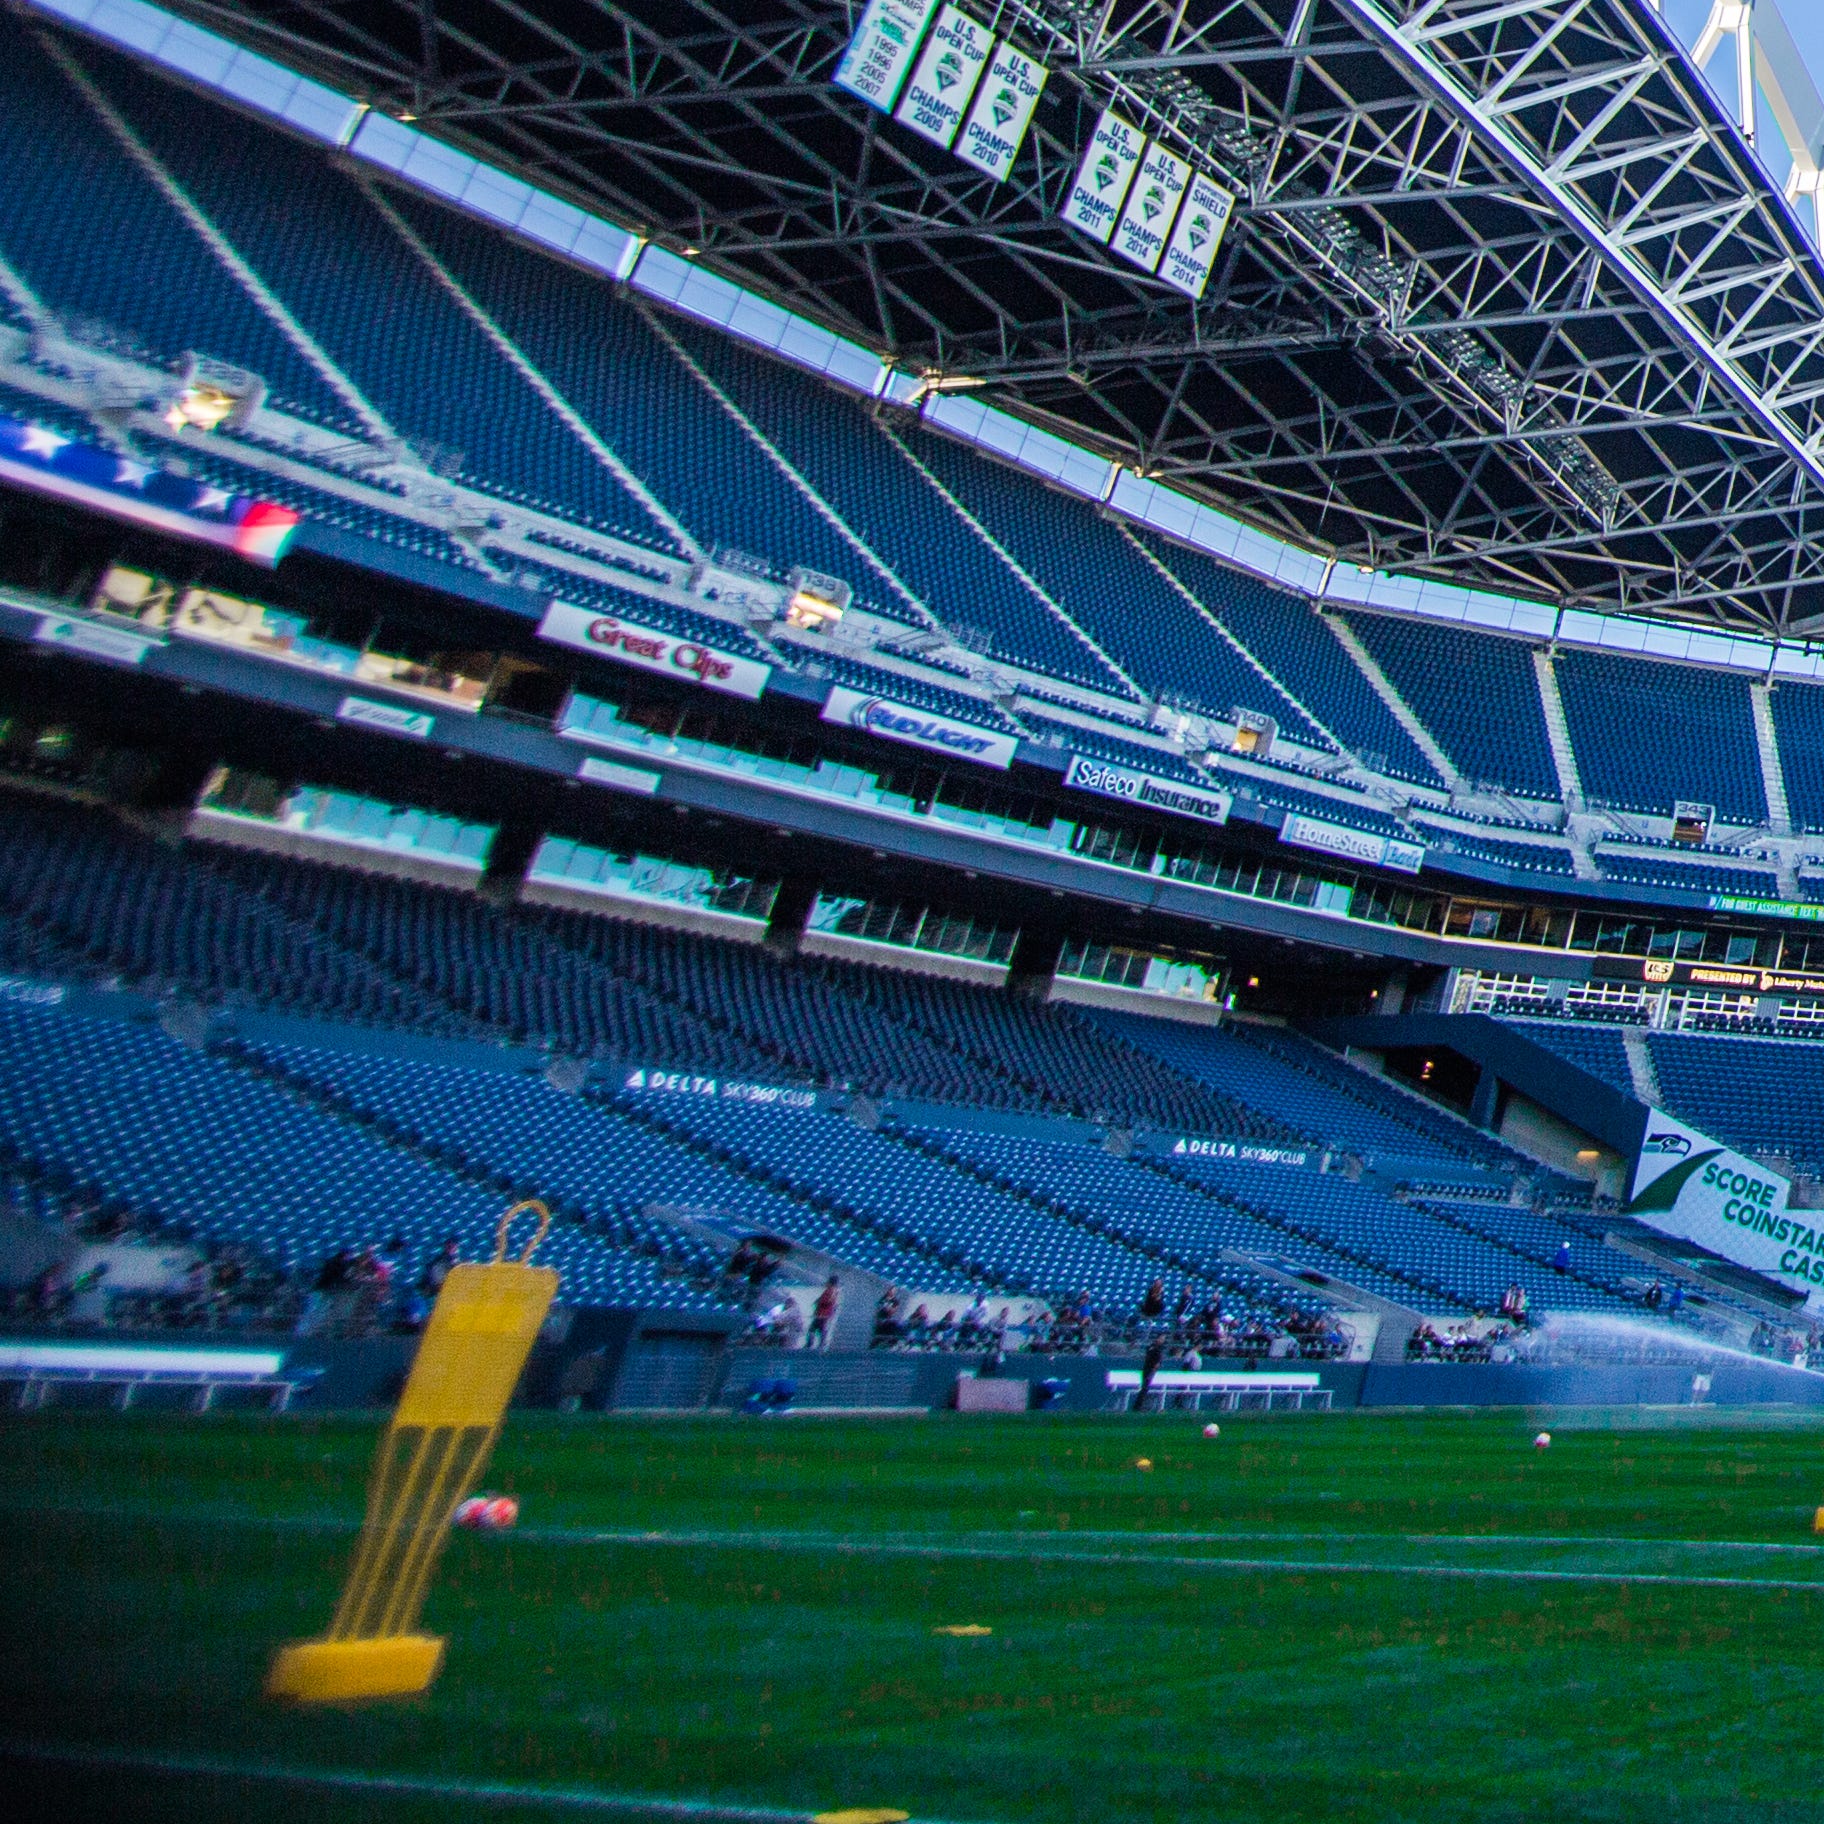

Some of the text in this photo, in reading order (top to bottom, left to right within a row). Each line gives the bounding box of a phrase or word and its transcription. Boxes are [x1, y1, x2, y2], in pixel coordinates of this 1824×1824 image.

[935, 26, 963, 51] OPEN
[963, 41, 986, 63] CUP
[954, 18, 978, 45] U.S.
[860, 61, 888, 85] 2005
[992, 62, 1041, 100] OPEN CUP
[1009, 54, 1031, 81] U.S.
[853, 74, 882, 98] 2007
[909, 86, 961, 126] CHAMPS
[913, 107, 944, 133] 2009
[967, 122, 1017, 160] CHAMPS
[1096, 130, 1139, 163] OPEN CUP
[1111, 122, 1131, 146] U.S.
[971, 142, 1000, 168] 2010
[1158, 154, 1177, 177] U.S.
[1144, 162, 1184, 194] OPEN CUP
[1073, 186, 1117, 223] CHAMPS
[1077, 206, 1102, 229] 2011
[1193, 190, 1227, 220] SHIELD
[1122, 217, 1164, 253] CHAMPS
[1124, 237, 1150, 260] 2014
[1168, 246, 1208, 279] CHAMPS
[1171, 264, 1196, 288] 2014
[589, 618, 734, 679] Great Clips
[1077, 760, 1221, 819] Safeco Insurance
[1678, 803, 1711, 814] 343
[1757, 902, 1796, 917] ASSISTANCE
[1691, 968, 1740, 984] PRESENTED
[1741, 972, 1756, 985] BY
[1775, 977, 1803, 991] Liberty
[650, 1071, 716, 1094] DELTA
[1189, 1140, 1236, 1158] DELTA
[1702, 1162, 1777, 1208] SCORE
